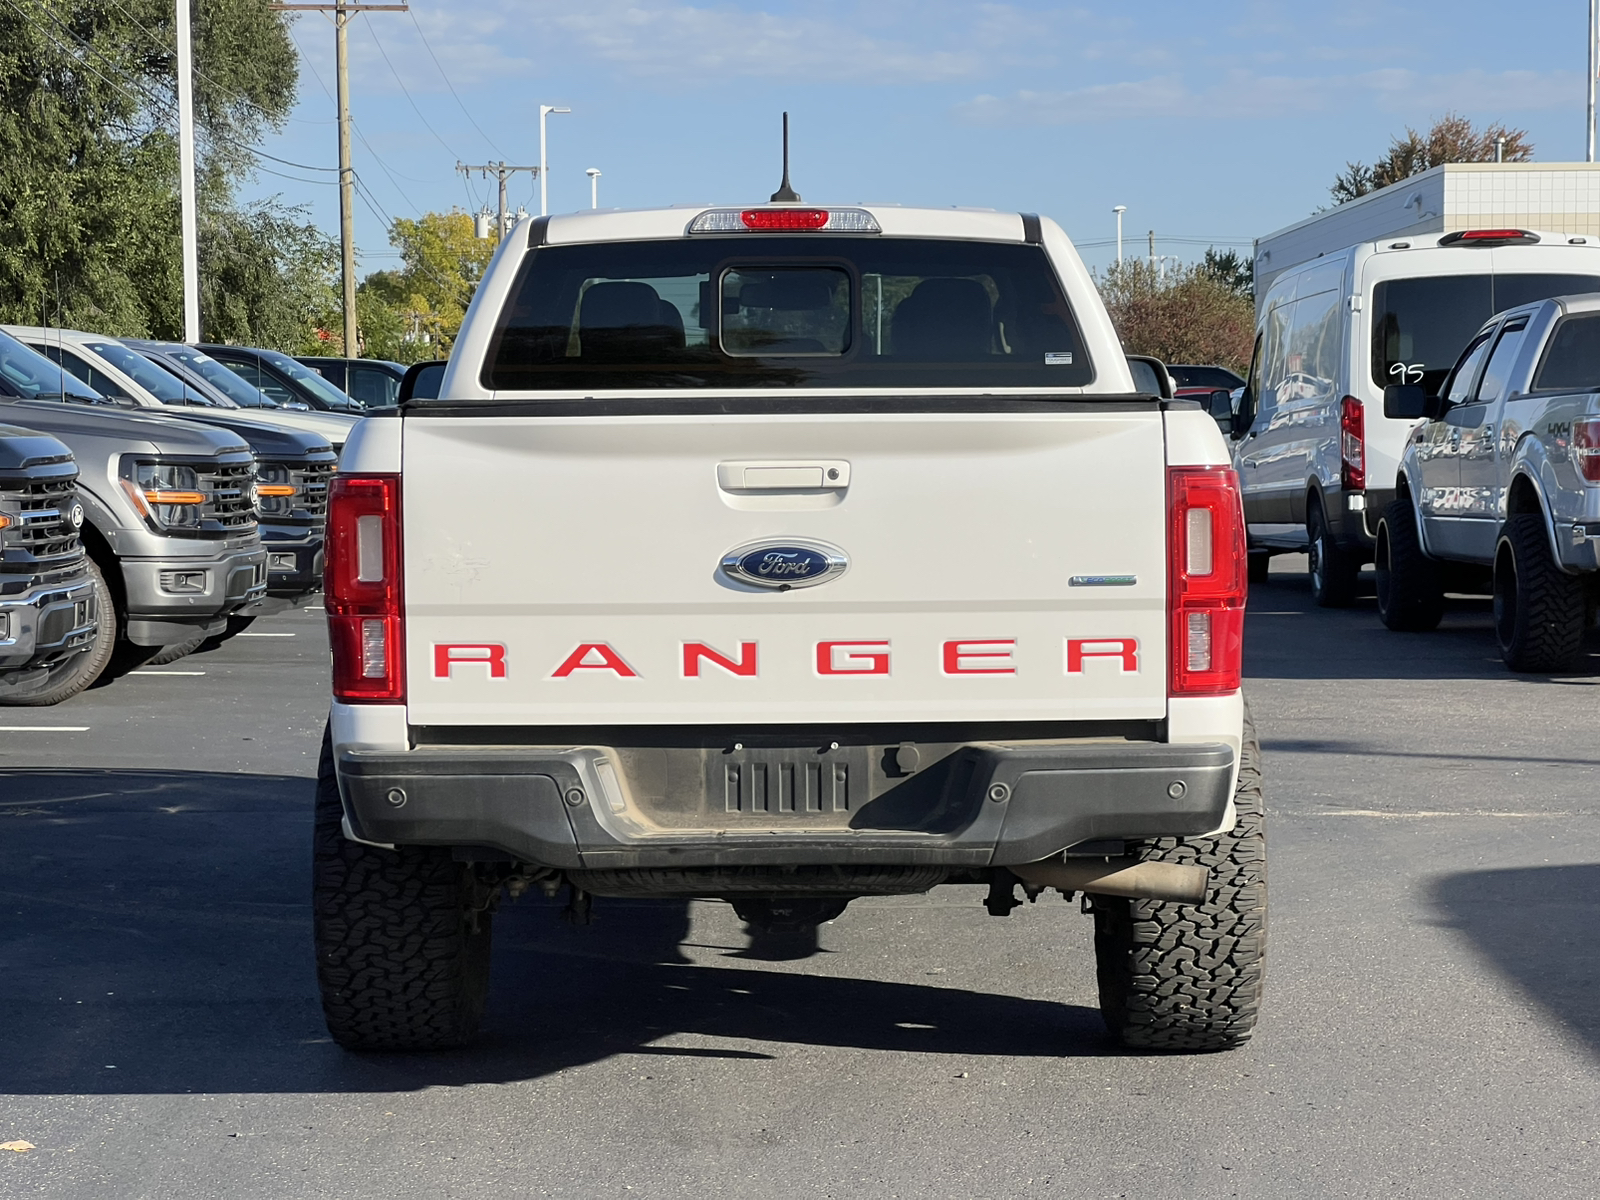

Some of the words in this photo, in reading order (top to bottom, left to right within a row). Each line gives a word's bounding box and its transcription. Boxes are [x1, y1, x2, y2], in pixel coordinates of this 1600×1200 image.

[1389, 362, 1425, 386] 95
[758, 551, 811, 575] Ford
[432, 637, 1139, 679] RANGER
